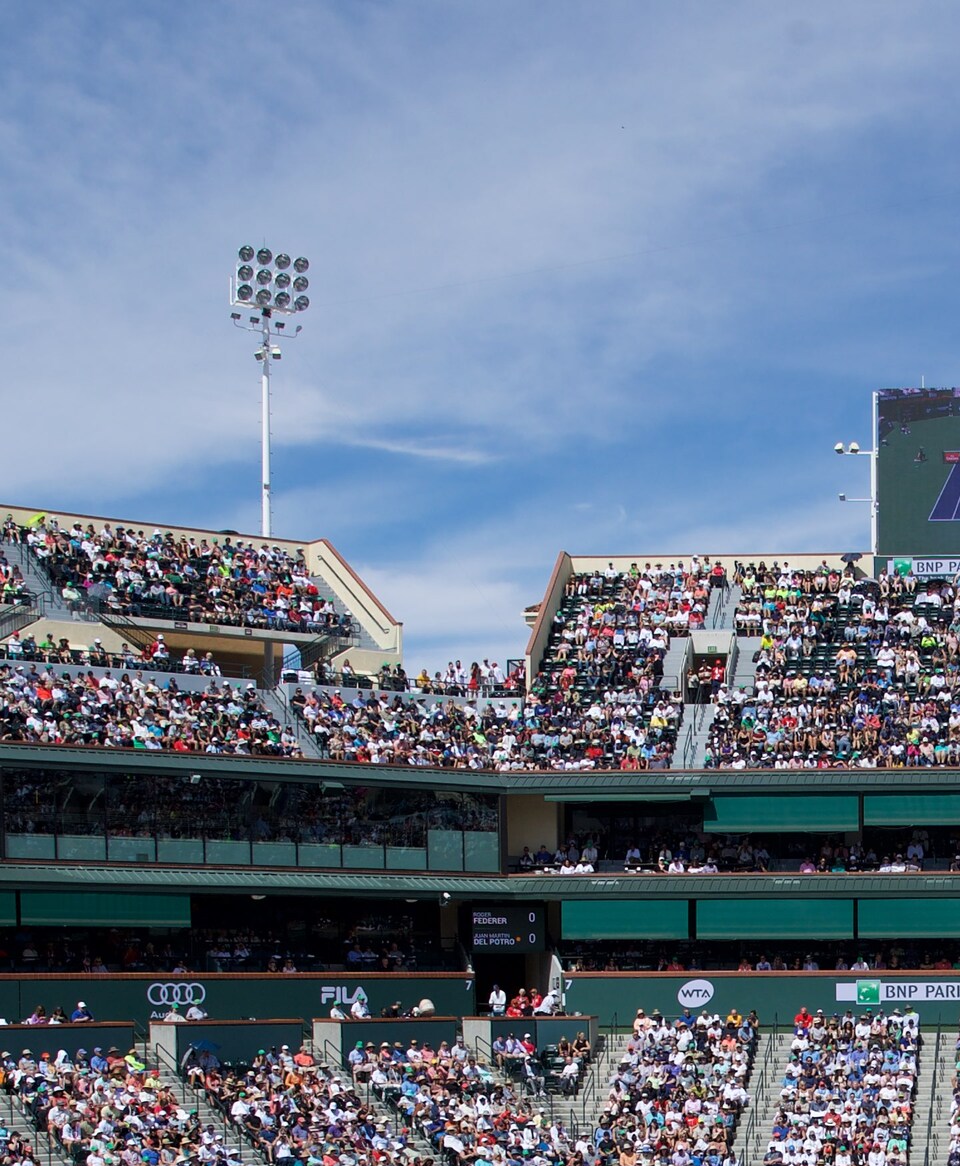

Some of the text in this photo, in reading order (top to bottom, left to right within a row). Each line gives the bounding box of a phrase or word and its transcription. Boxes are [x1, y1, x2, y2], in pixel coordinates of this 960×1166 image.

[917, 562, 943, 573] BNP
[528, 912, 536, 922] 0
[528, 933, 536, 943] 0
[465, 980, 473, 990] 7
[565, 980, 573, 989] 7
[321, 986, 368, 1004] FILA
[681, 988, 710, 998] WTA
[885, 985, 918, 998] BNP
